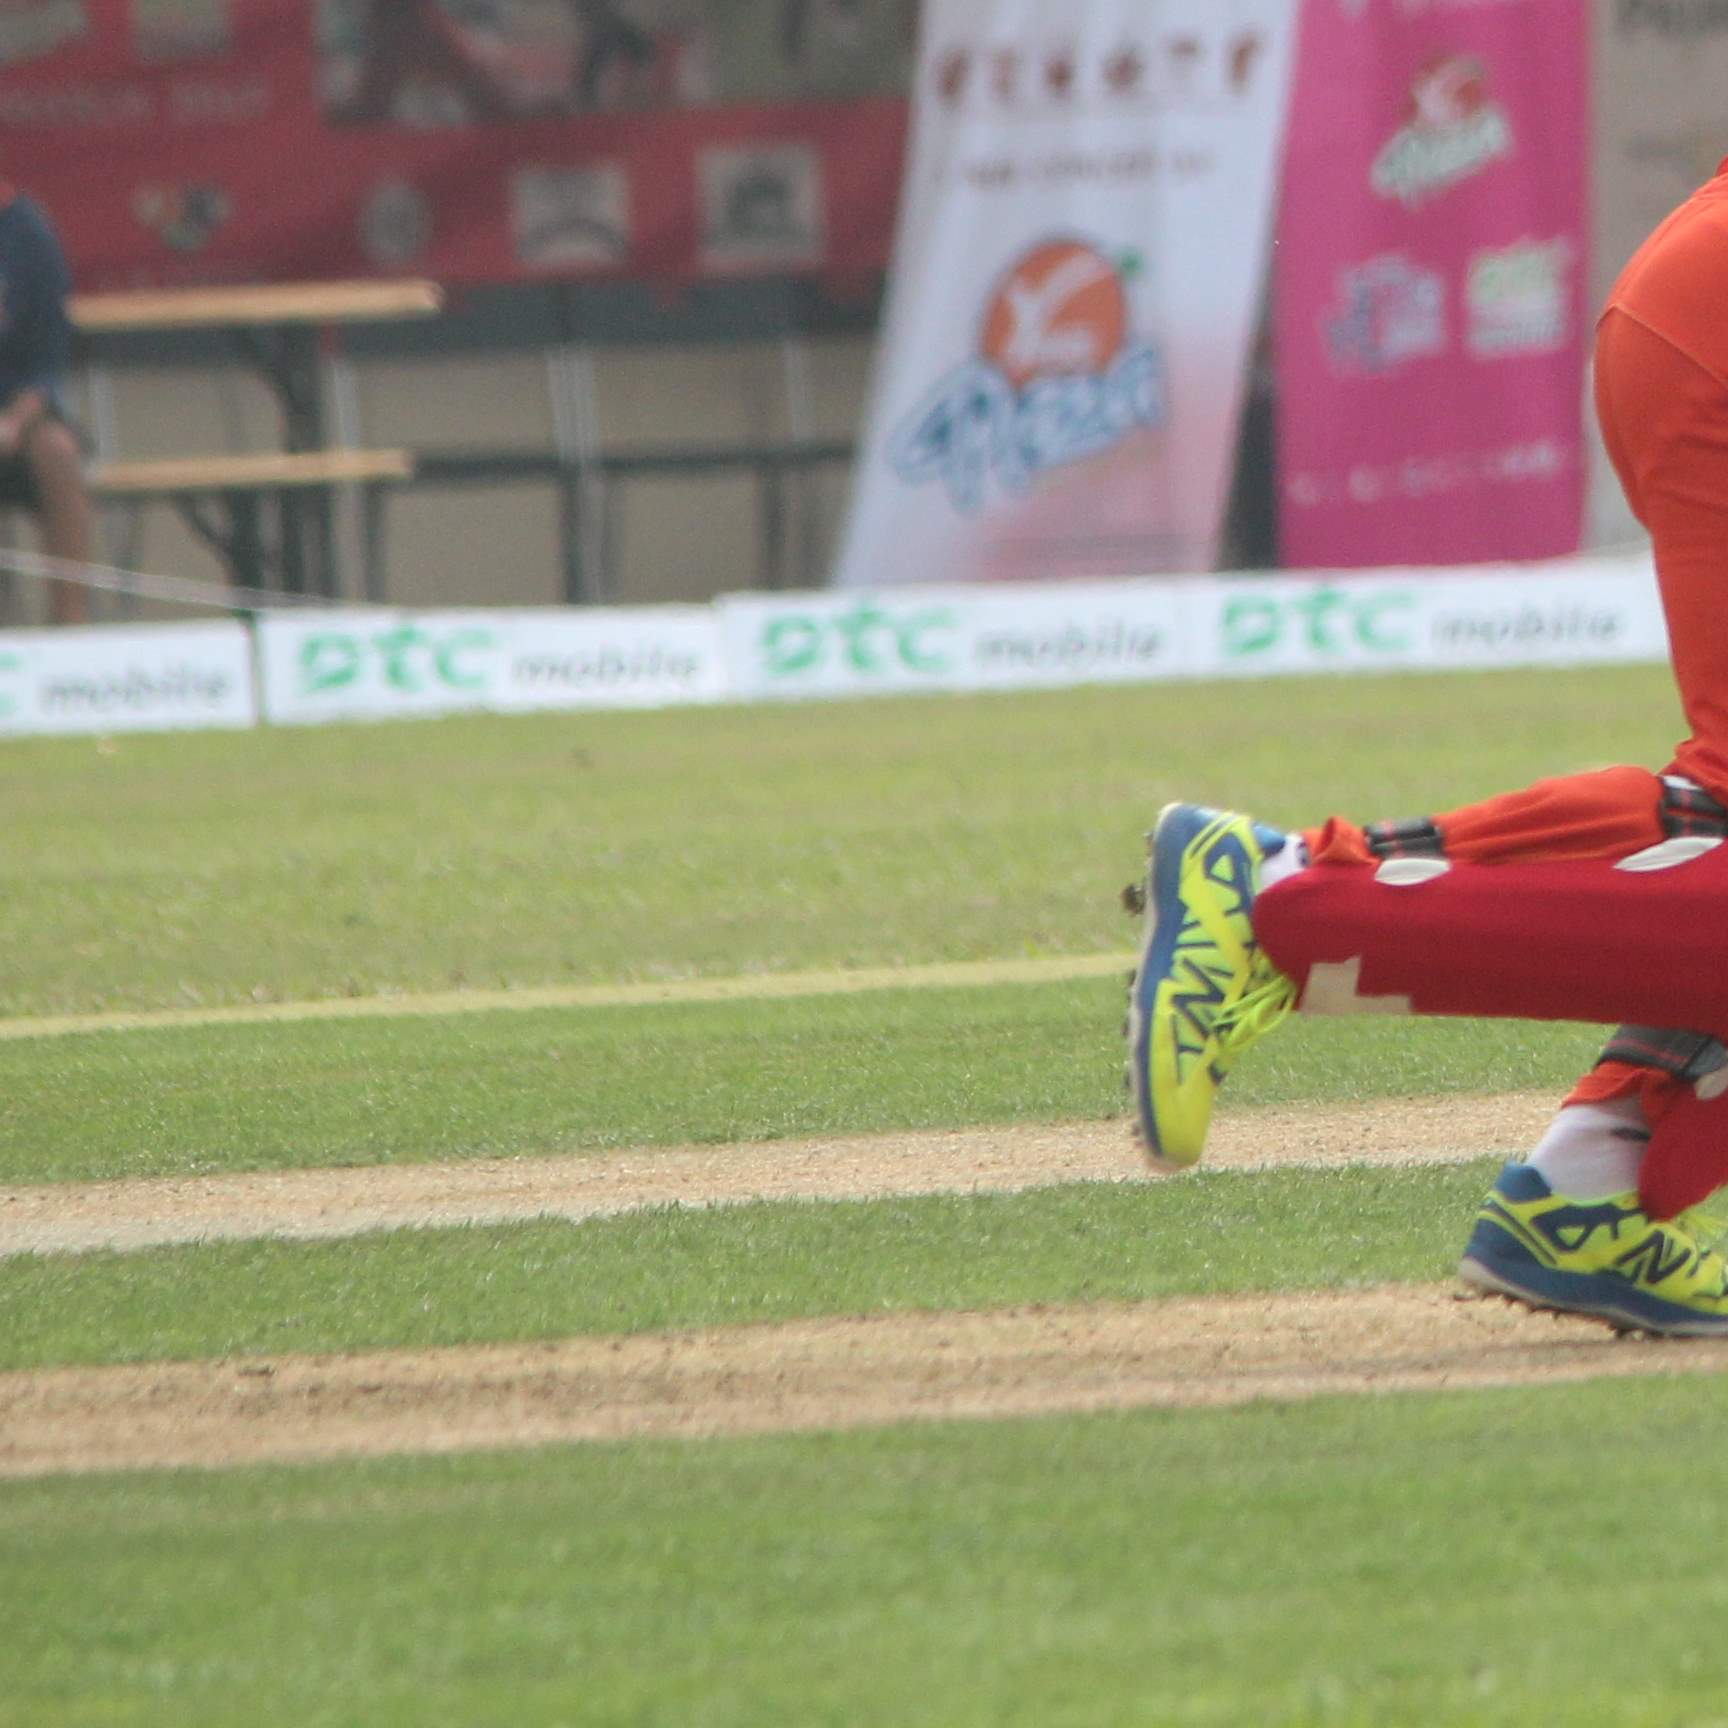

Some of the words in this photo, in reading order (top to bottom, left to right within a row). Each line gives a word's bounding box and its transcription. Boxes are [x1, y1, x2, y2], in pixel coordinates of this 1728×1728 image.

[976, 619, 1164, 666] mobile
[1432, 601, 1622, 647] mobile
[510, 642, 698, 688] mobile
[42, 665, 229, 713] mobile
